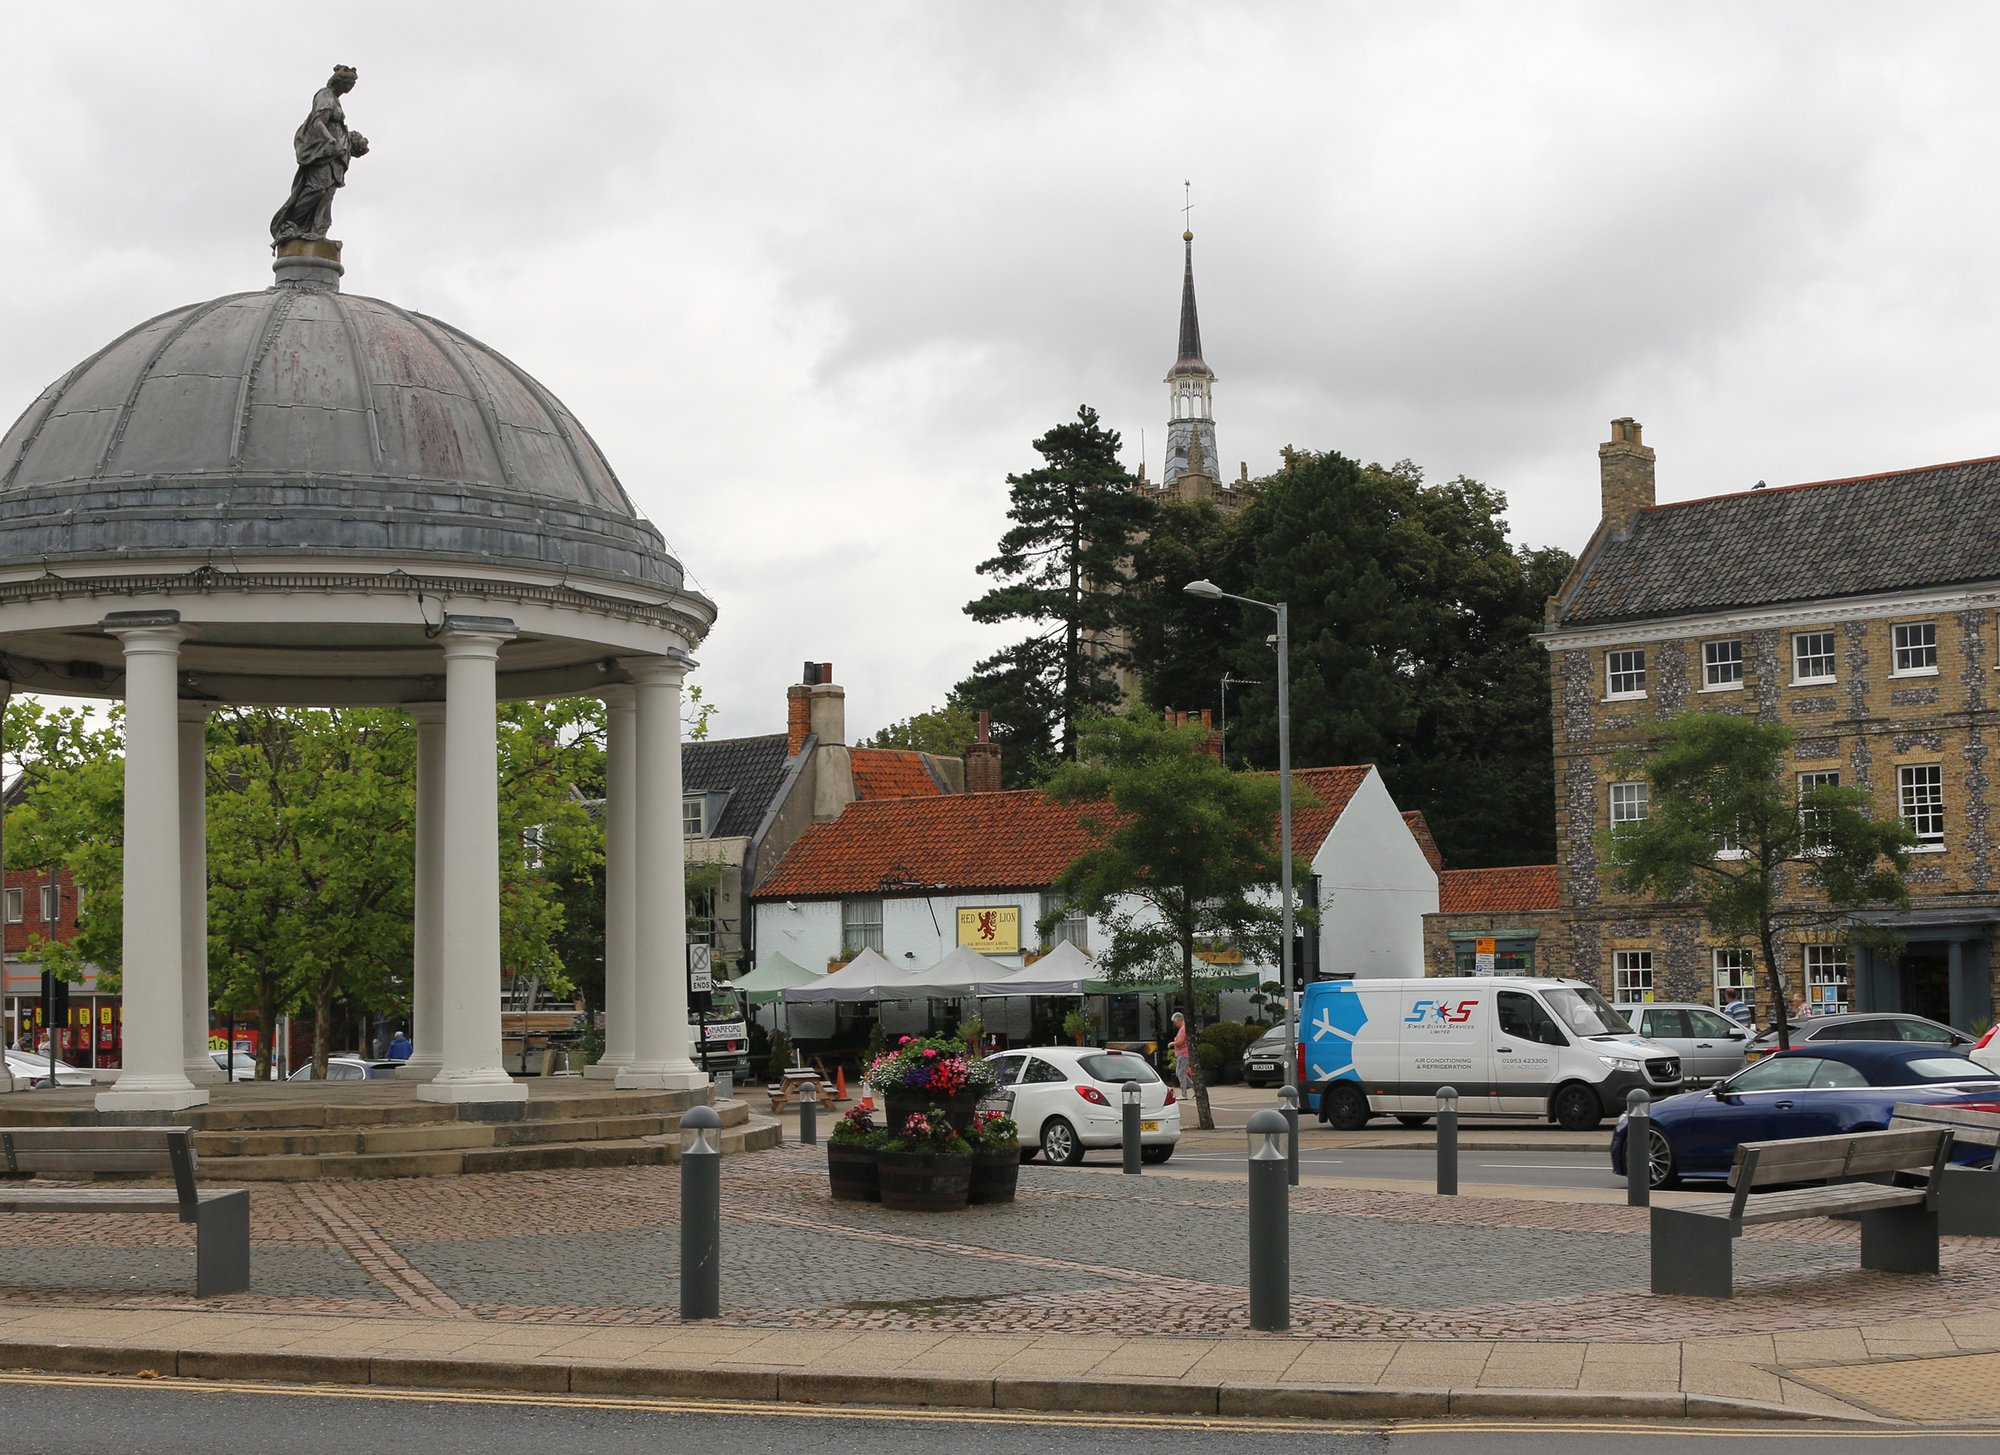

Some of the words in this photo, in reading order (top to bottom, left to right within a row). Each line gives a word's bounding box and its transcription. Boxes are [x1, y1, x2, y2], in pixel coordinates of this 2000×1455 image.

[960, 913, 976, 924] RED
[999, 912, 1016, 922] LION
[693, 981, 710, 989] ENDS
